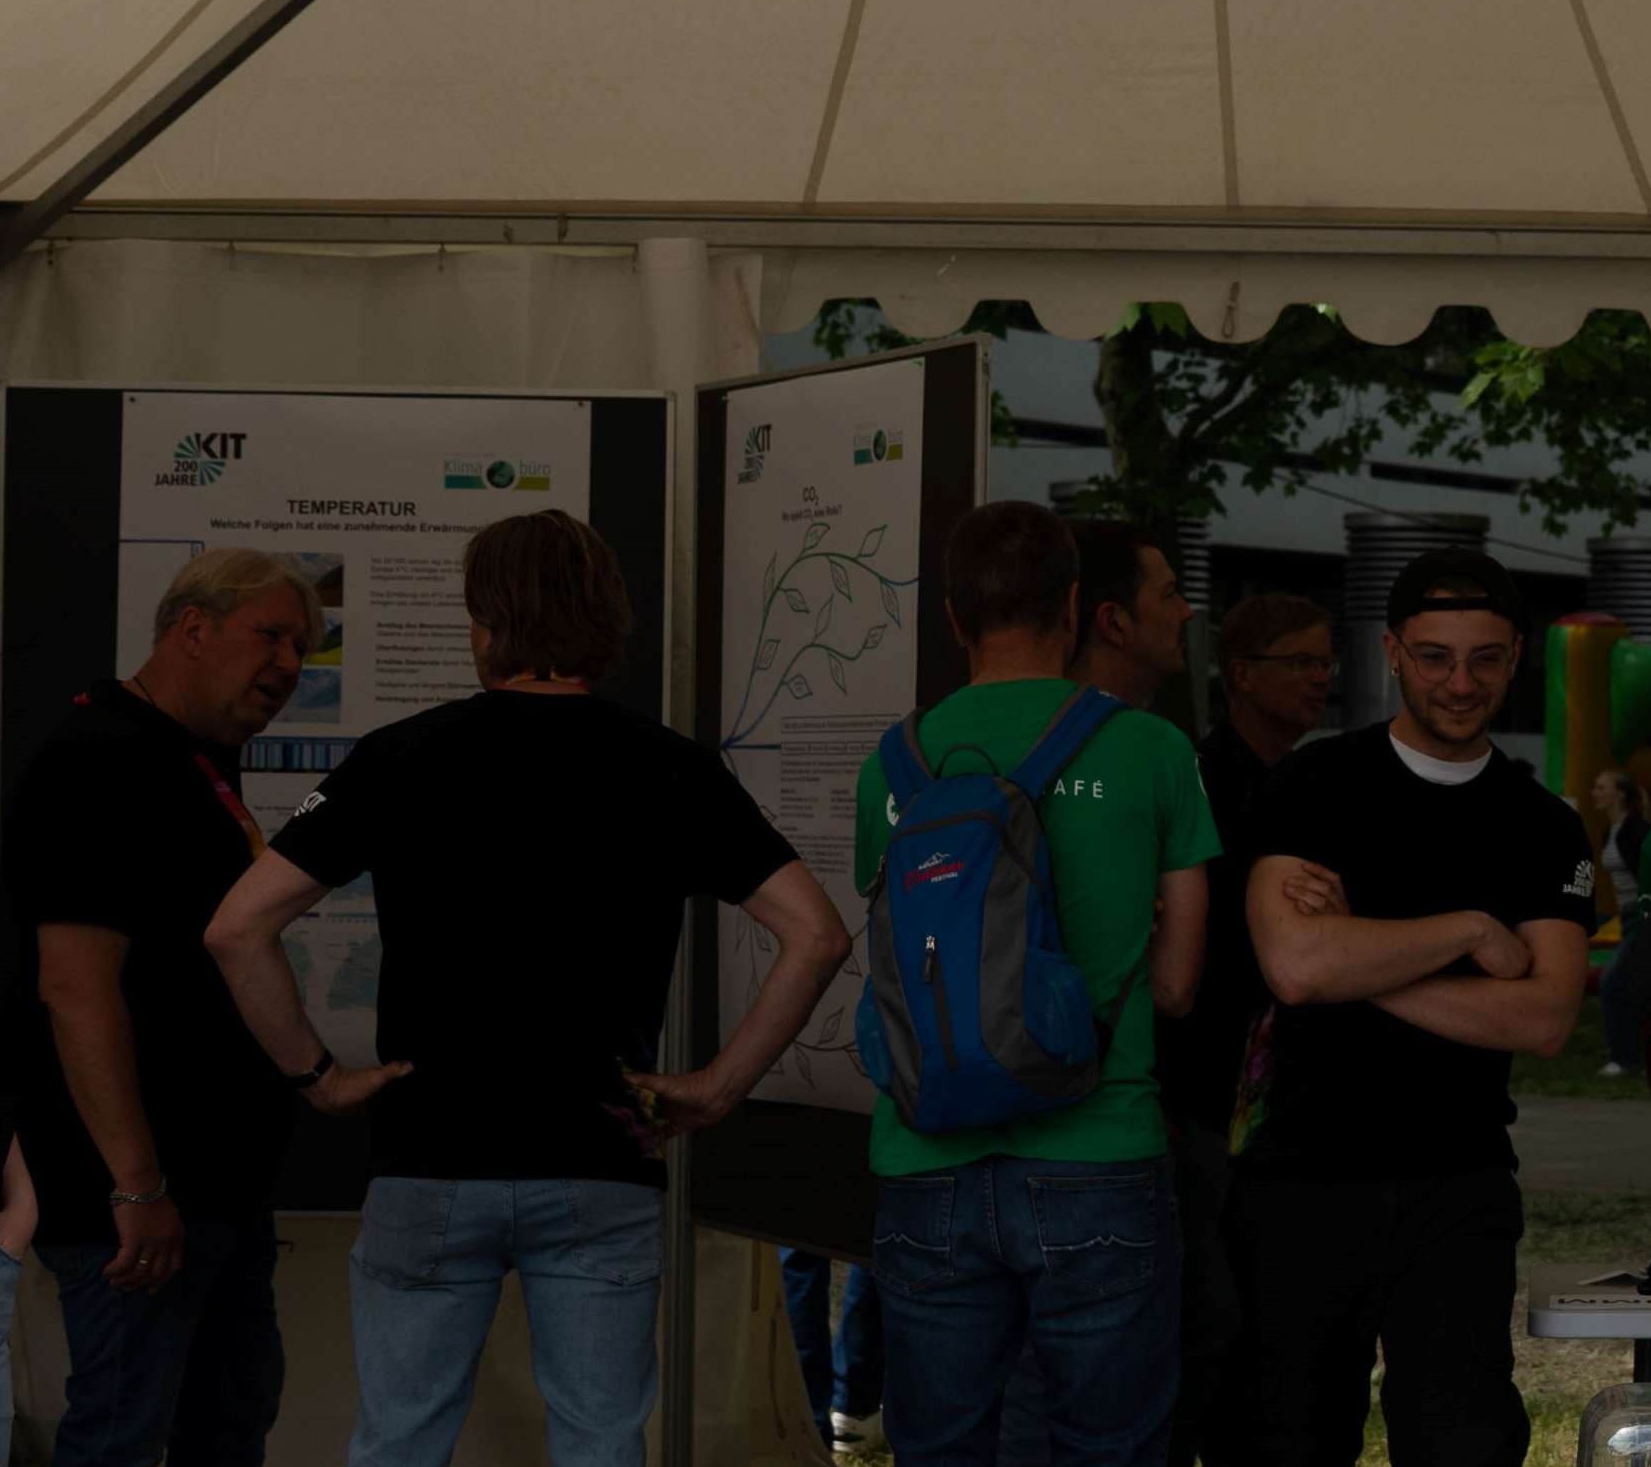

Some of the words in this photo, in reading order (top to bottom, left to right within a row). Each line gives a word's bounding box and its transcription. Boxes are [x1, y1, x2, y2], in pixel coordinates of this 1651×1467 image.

[193, 432, 247, 459] KIT
[173, 459, 198, 472] 200
[155, 473, 197, 487] JAHRE
[286, 499, 417, 517] TEMPERATUR
[210, 518, 252, 530] Welche
[254, 519, 293, 533] Folgen
[295, 520, 316, 531] hat
[343, 521, 417, 534] zunehmende
[1042, 778, 1104, 799] AFÉ
